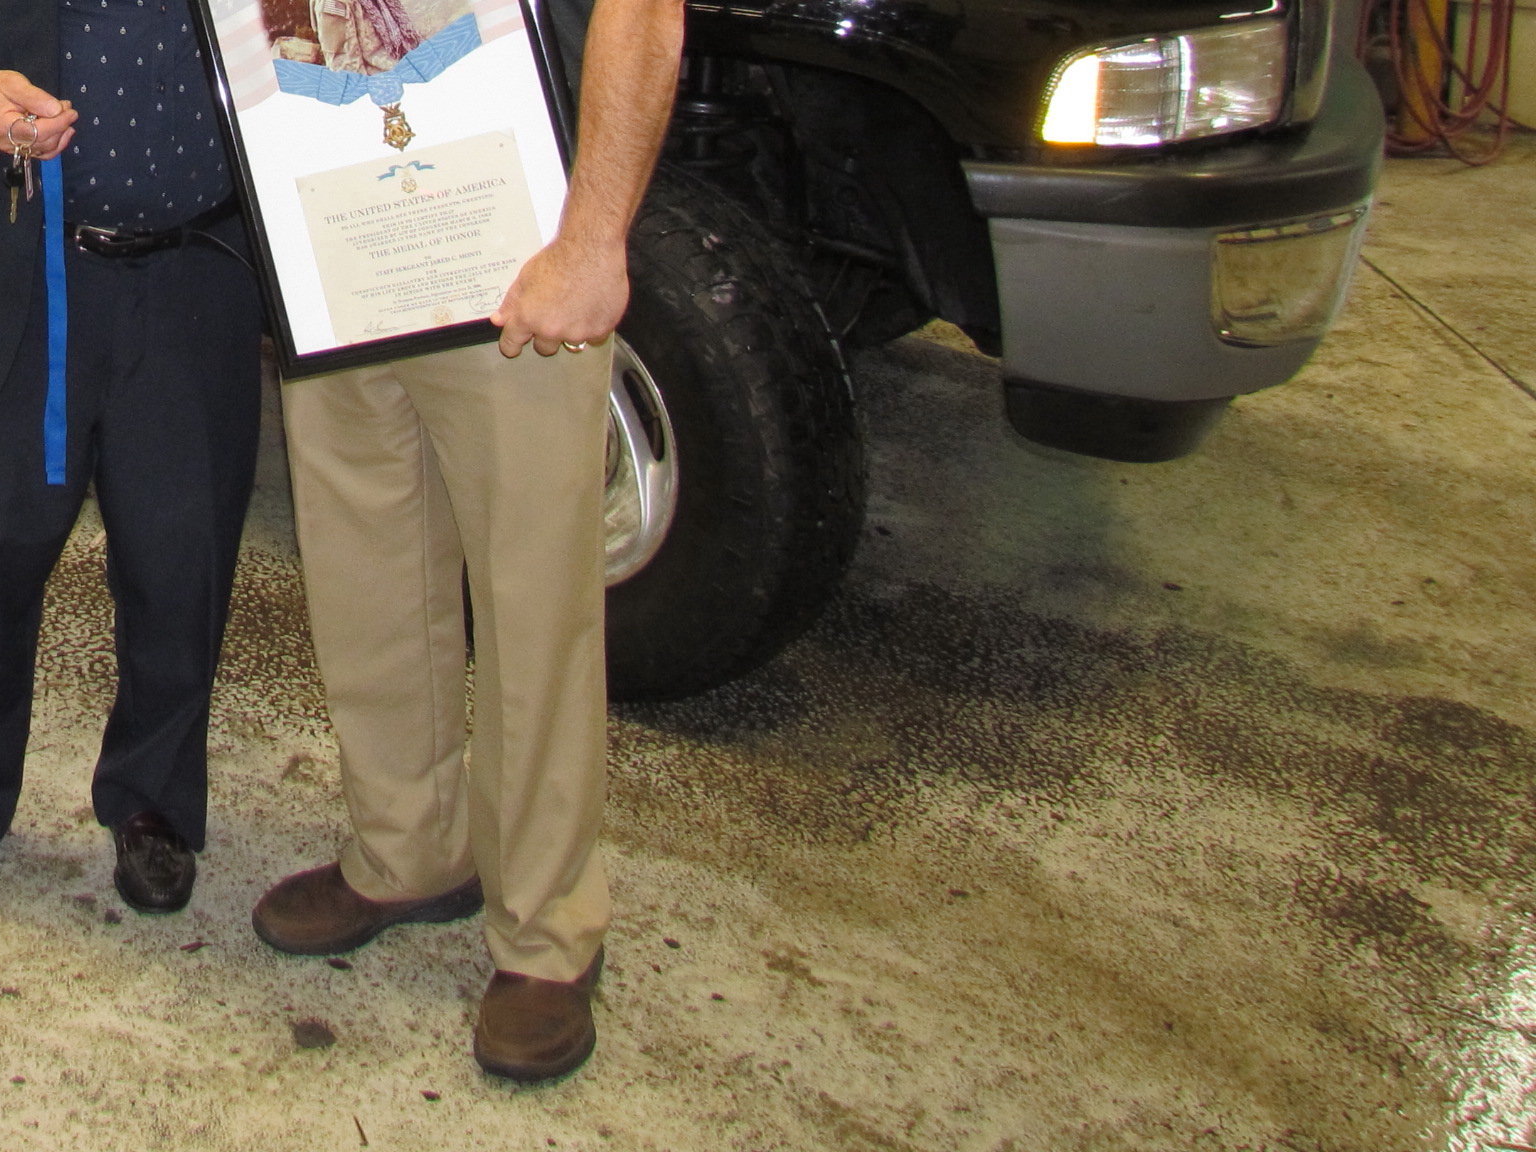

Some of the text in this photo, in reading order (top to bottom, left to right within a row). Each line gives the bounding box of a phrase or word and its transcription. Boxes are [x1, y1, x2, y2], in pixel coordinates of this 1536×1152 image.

[323, 176, 506, 224] THE UNITED STATES OF AMERICA
[368, 228, 480, 259] THE MEDAL OF HONOR
